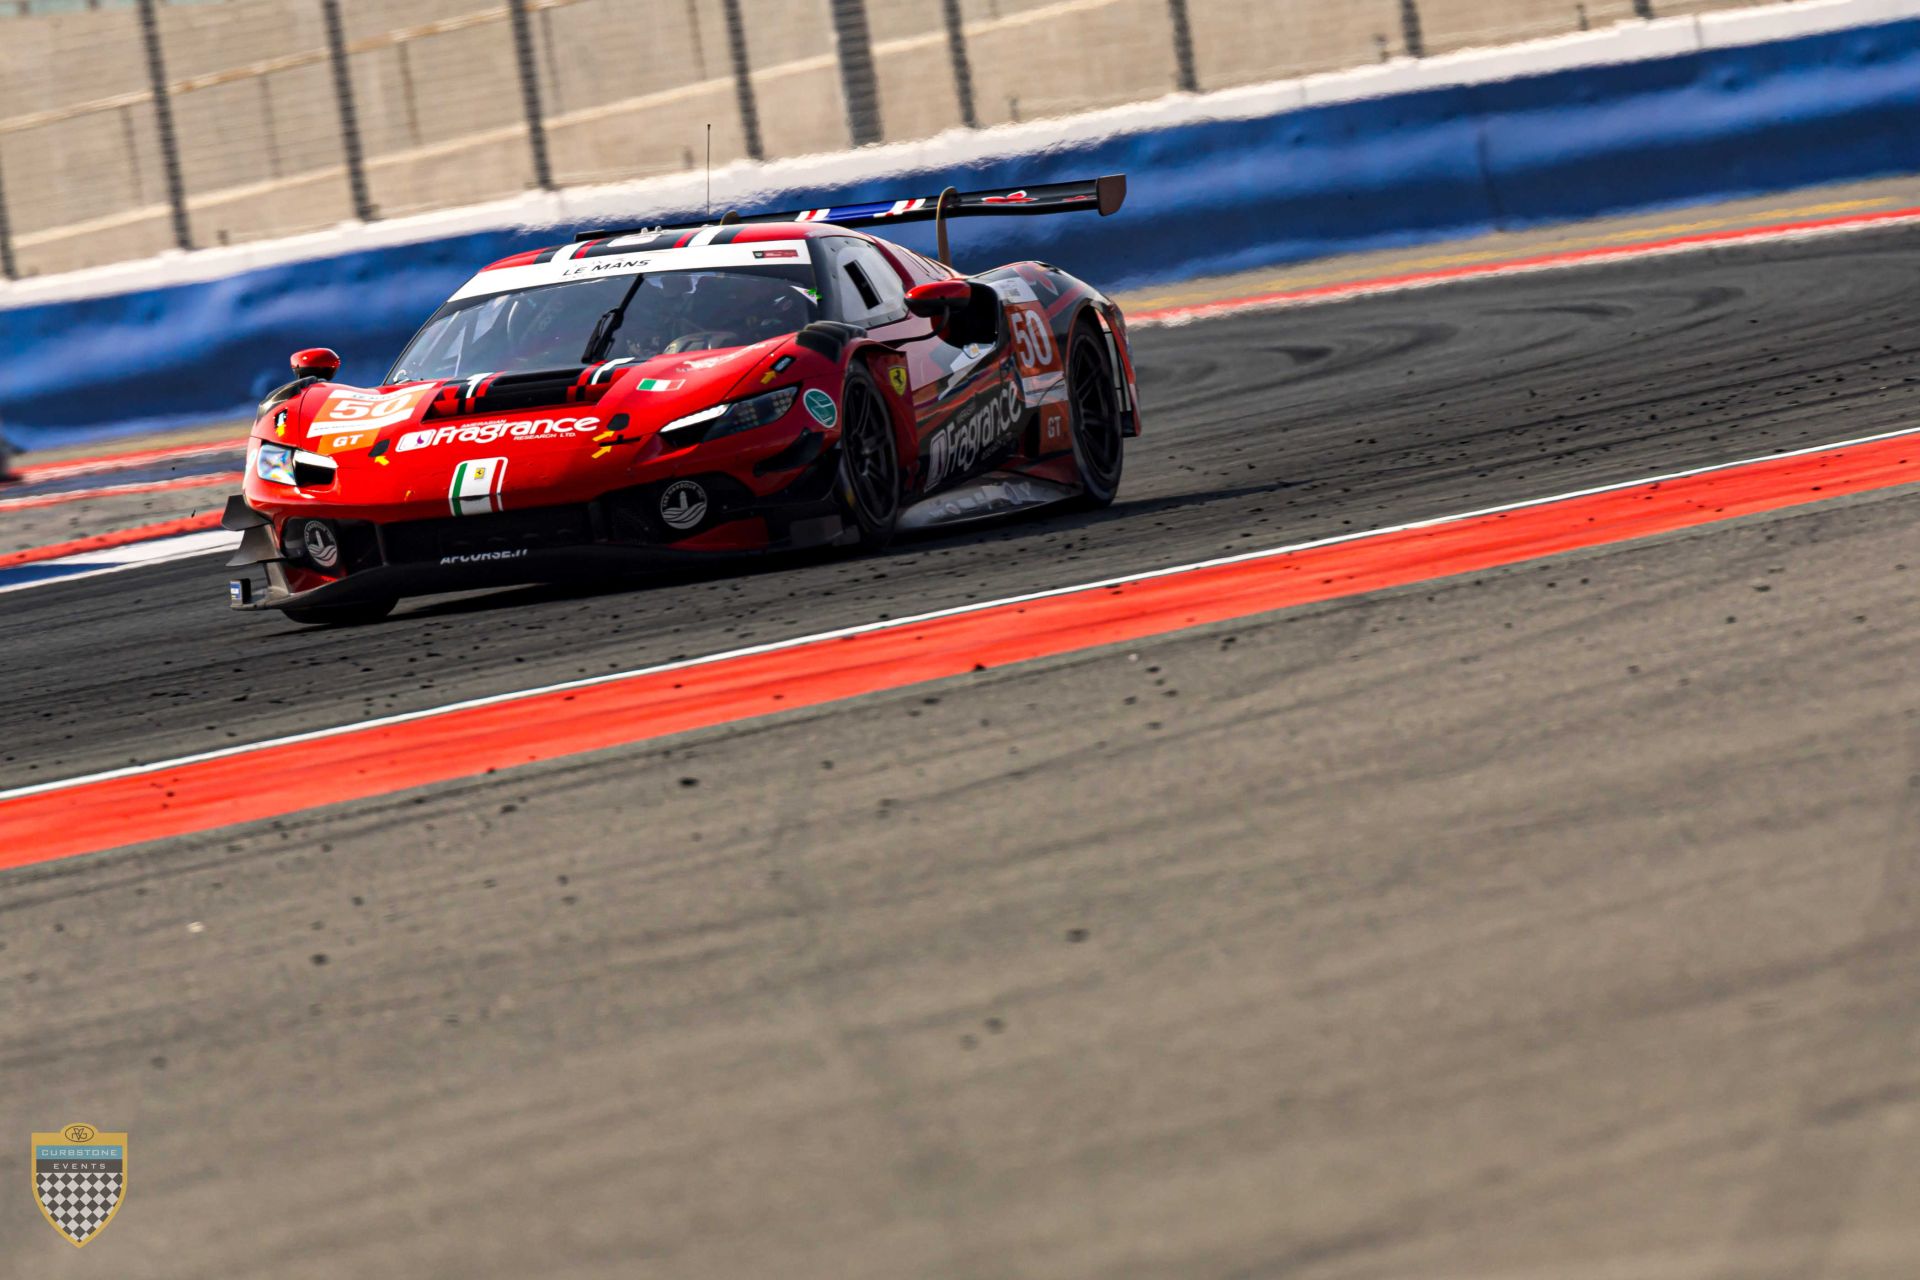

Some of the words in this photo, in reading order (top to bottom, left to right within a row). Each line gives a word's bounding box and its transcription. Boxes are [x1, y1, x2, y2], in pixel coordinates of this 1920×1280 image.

[563, 266, 588, 276] LE
[592, 259, 651, 271] MANS
[1011, 310, 1052, 369] 50
[329, 394, 412, 419] 50
[431, 416, 600, 446] Fragrance
[513, 433, 557, 441] RESEARCH
[943, 380, 1022, 478] Fragrance
[1048, 415, 1062, 439] GT
[333, 434, 364, 448] GT
